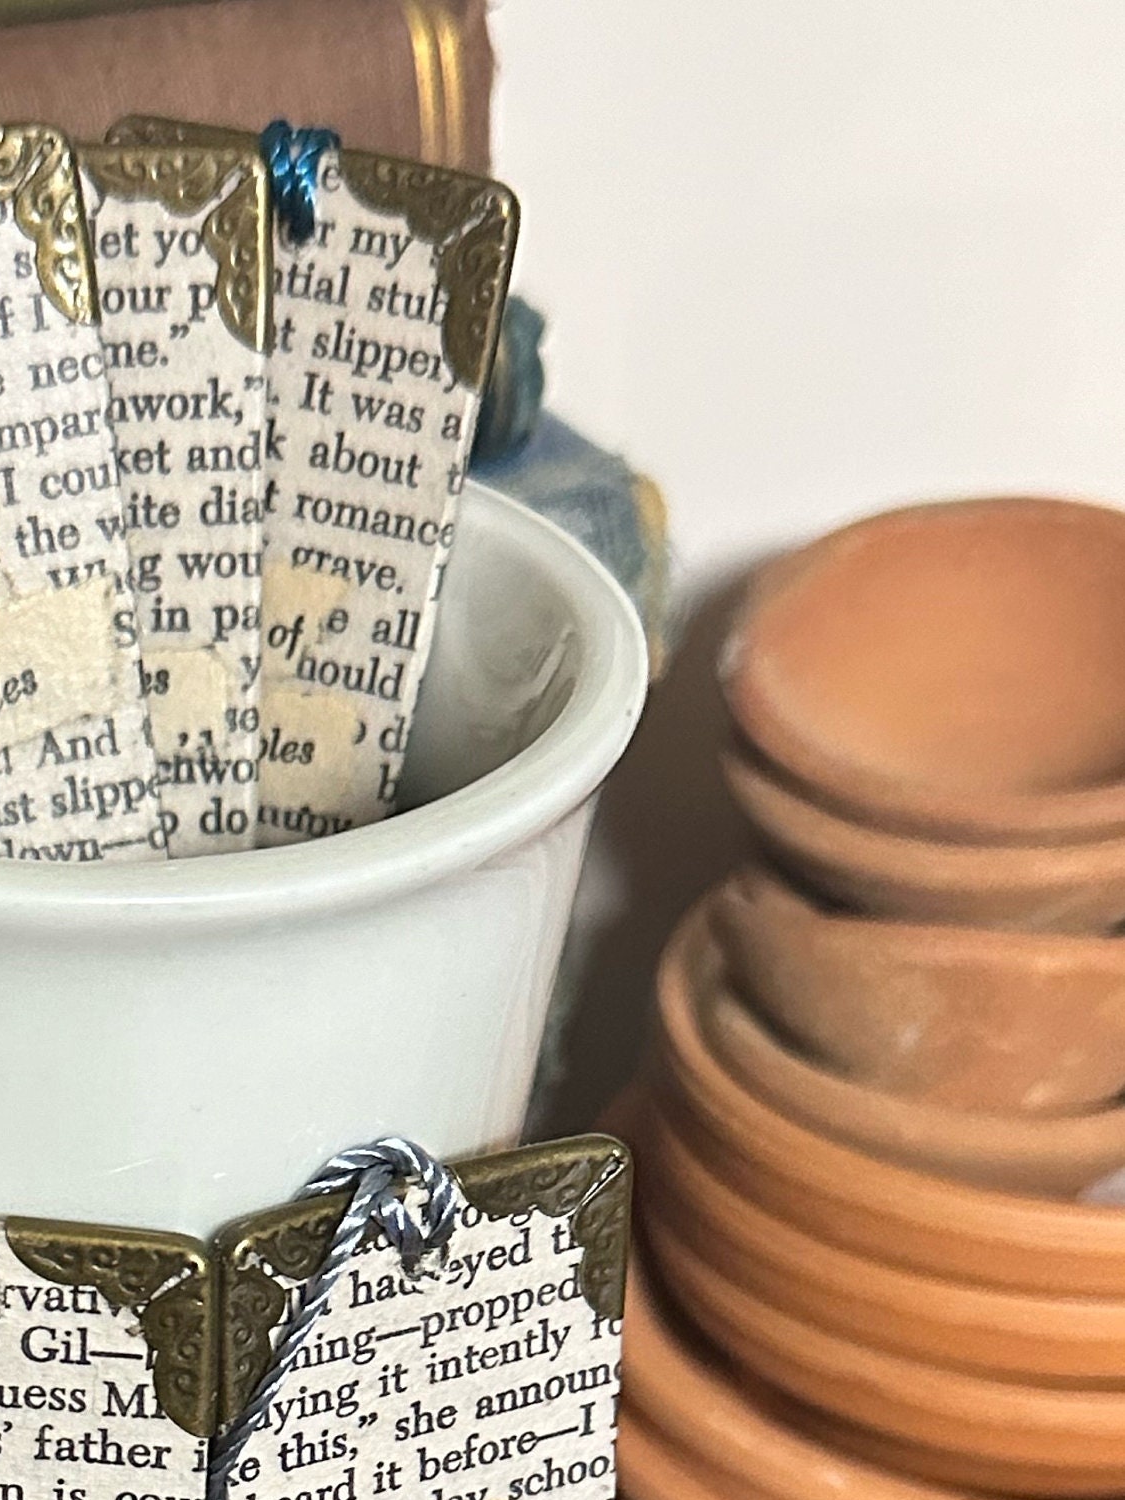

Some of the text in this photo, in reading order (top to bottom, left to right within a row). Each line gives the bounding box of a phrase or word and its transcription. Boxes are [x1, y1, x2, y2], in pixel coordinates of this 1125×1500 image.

[350, 223, 413, 270] my
[298, 371, 425, 433] It was
[309, 431, 423, 488] about
[15, 515, 80, 558] the
[295, 490, 455, 549] romance
[151, 606, 191, 633] in
[268, 616, 304, 661] of
[371, 609, 422, 651] all
[38, 717, 121, 767] And
[425, 1317, 572, 1385] intently
[394, 1399, 459, 1442] she
[33, 1423, 173, 1471] father
